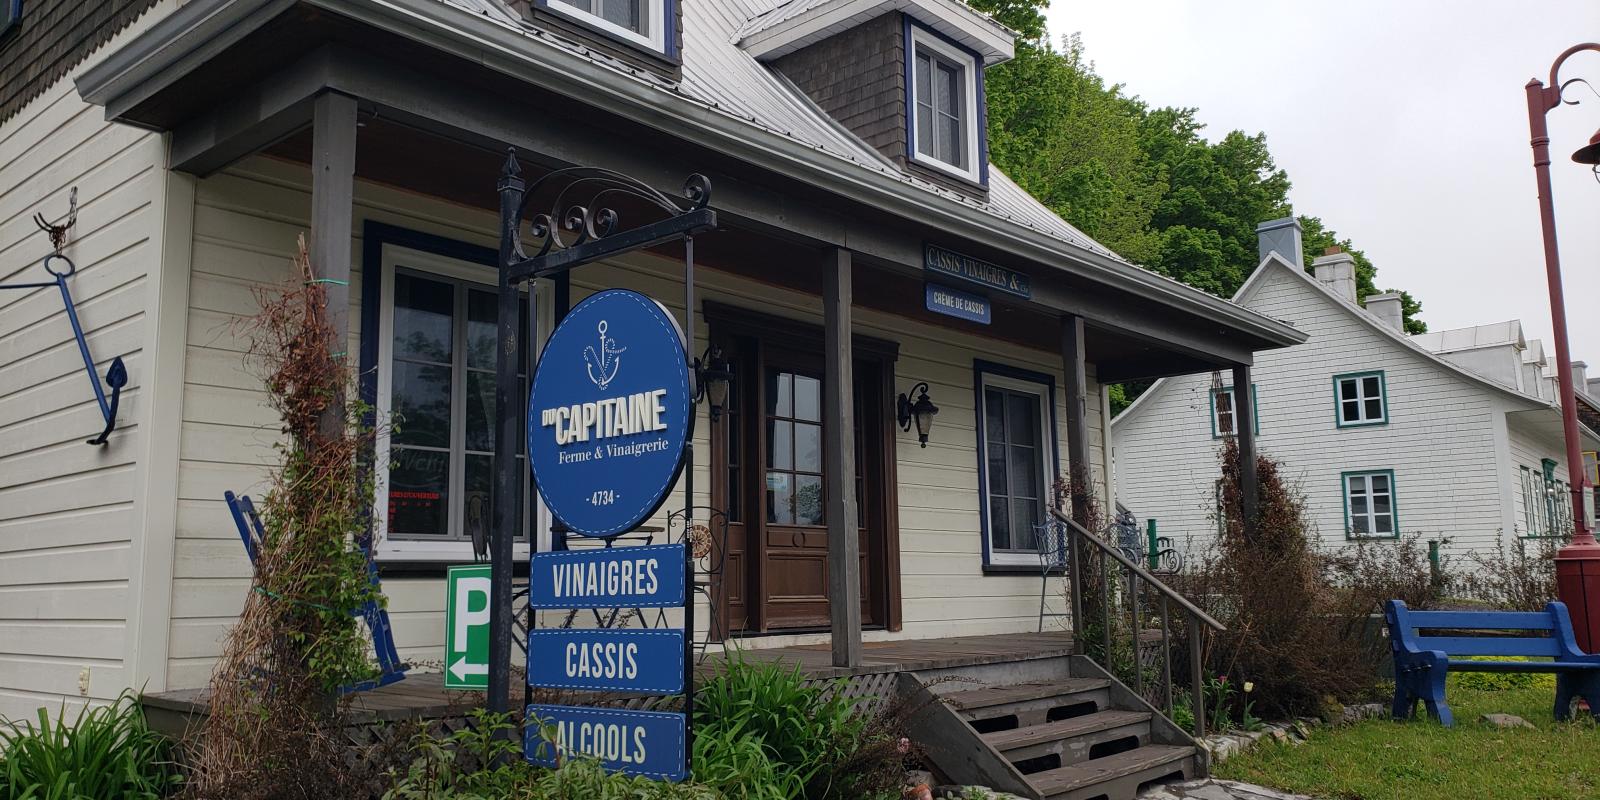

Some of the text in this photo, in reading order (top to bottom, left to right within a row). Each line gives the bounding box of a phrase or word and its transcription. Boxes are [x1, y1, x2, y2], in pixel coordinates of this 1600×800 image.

[928, 247, 960, 273] CASSIS
[963, 258, 1007, 287] VINAIGRES
[1009, 273, 1019, 291] &
[933, 291, 985, 315] CRÈME DE CASSIS
[542, 389, 668, 446] DU CAPITAINE
[558, 437, 669, 465] Ferme & Vinaigrerie
[591, 489, 614, 506] 4734
[552, 558, 659, 598] VINAIGRES
[454, 576, 492, 652] P
[565, 642, 638, 680] CASSIS
[556, 720, 646, 764] ALCOOLS
